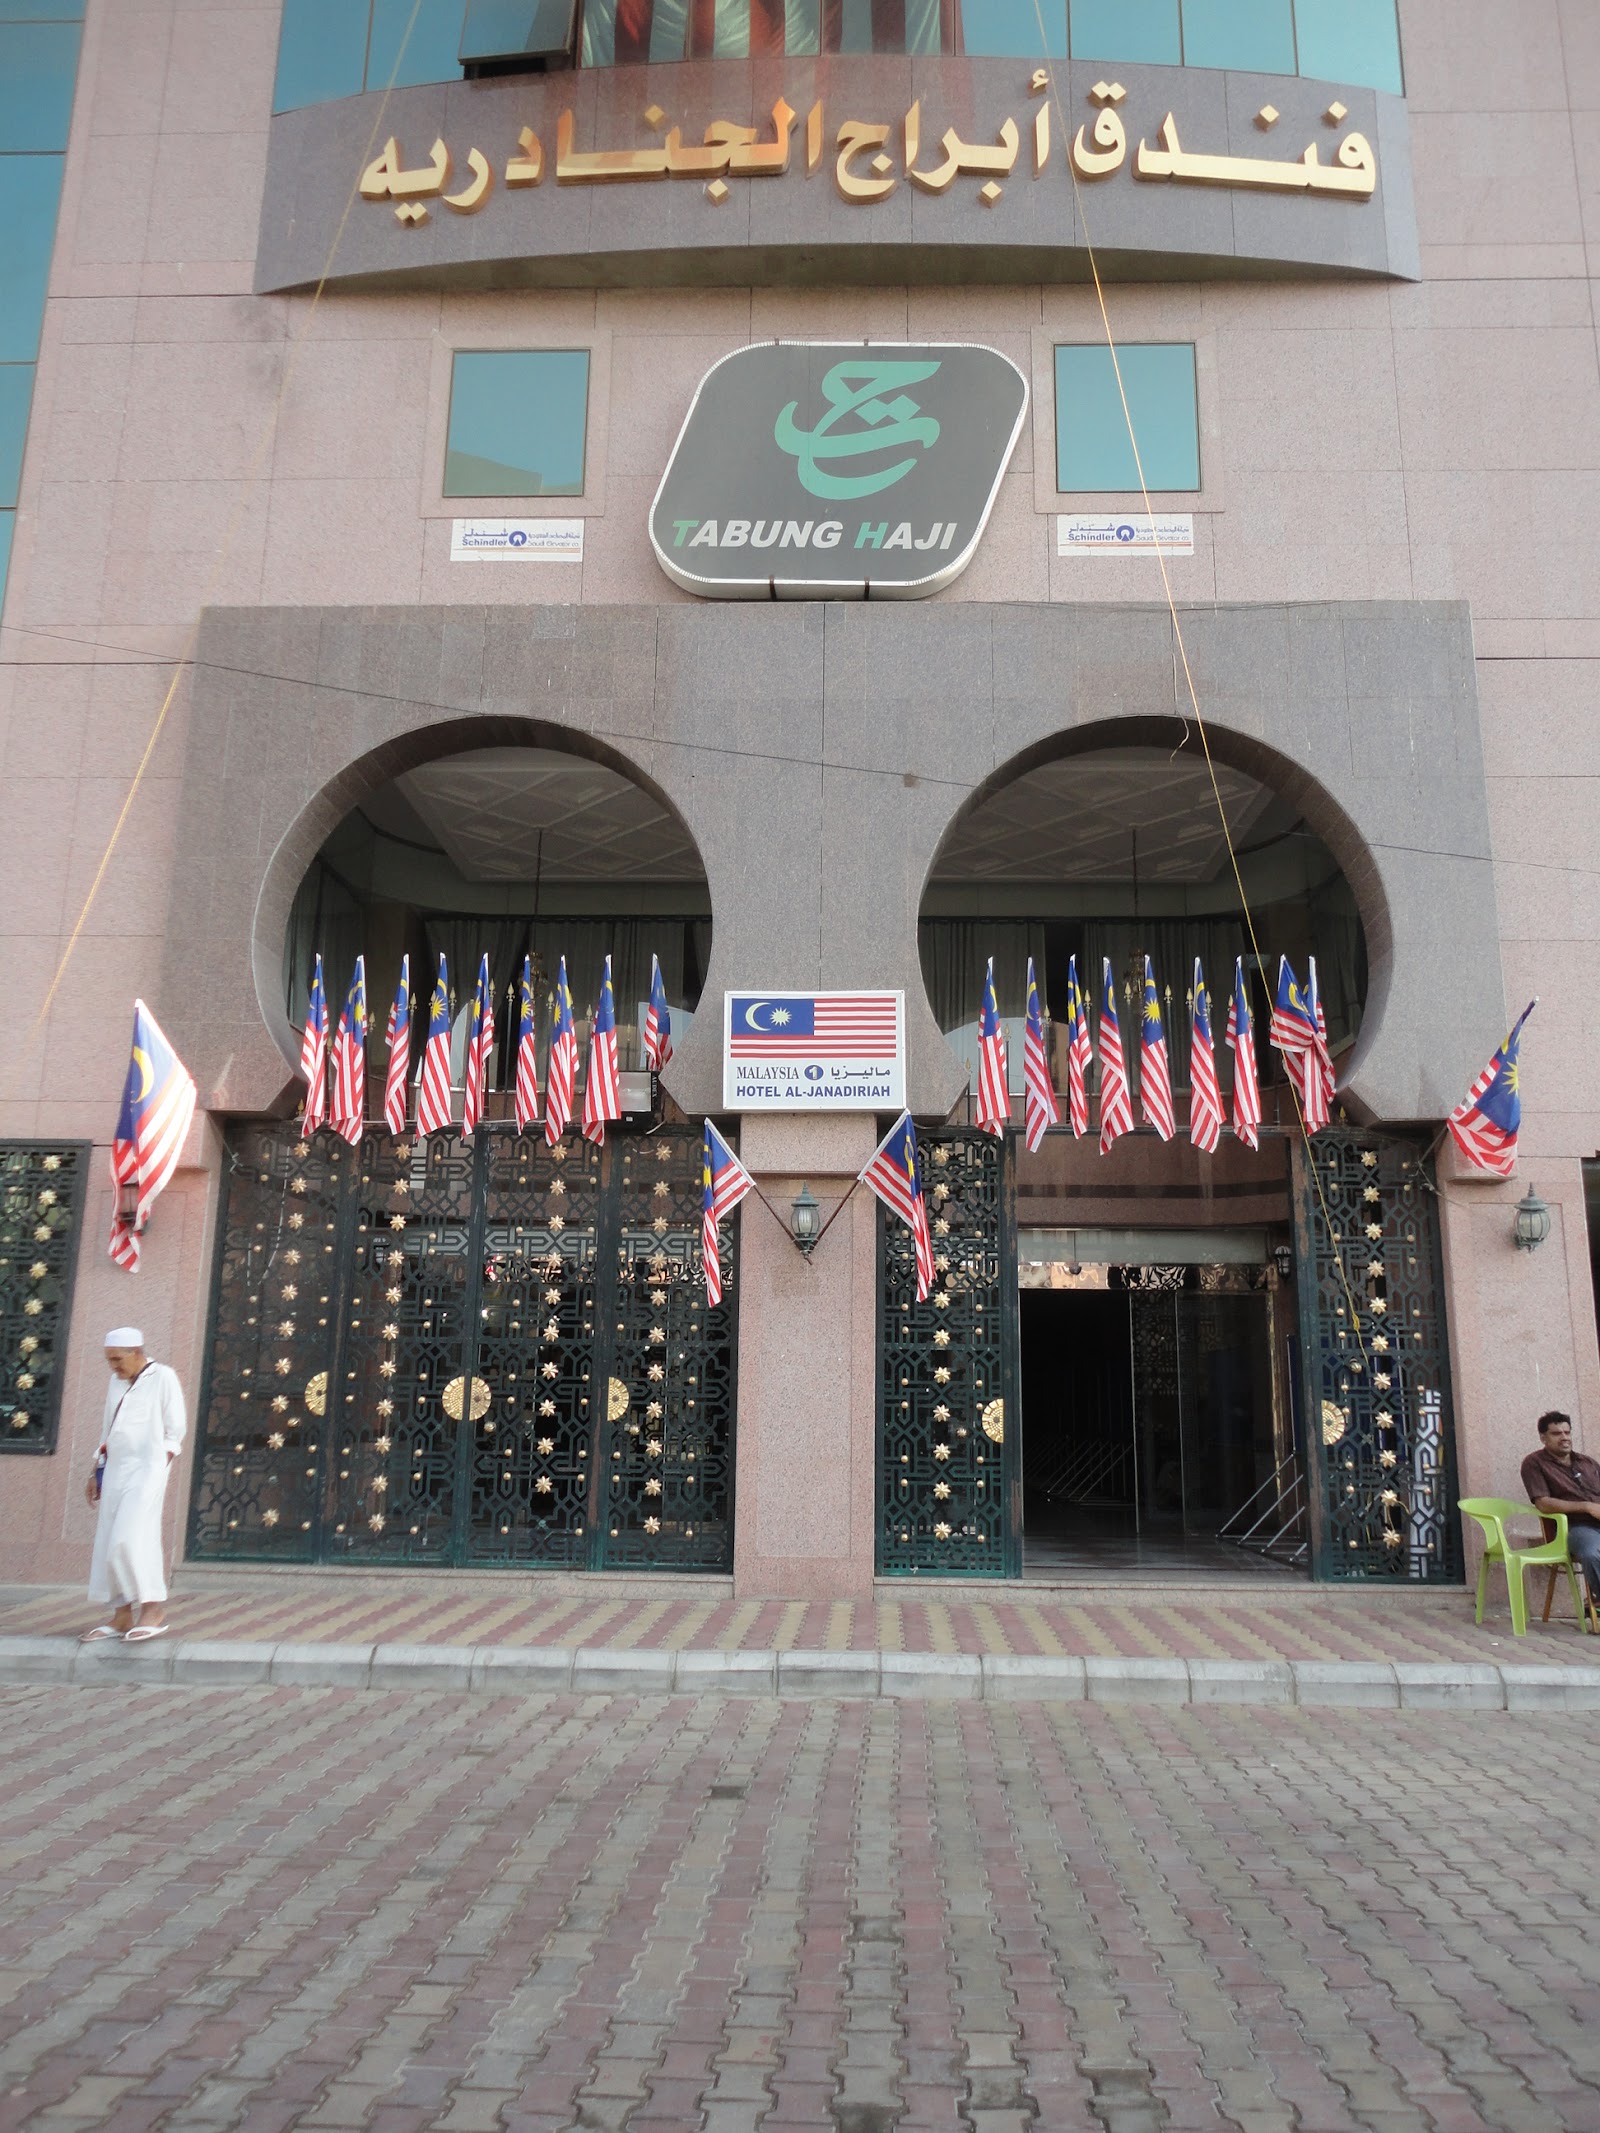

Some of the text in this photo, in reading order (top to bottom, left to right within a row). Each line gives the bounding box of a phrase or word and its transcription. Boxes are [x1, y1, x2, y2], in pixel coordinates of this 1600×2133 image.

[836, 68, 1050, 208] أبراج
[1072, 80, 1377, 202] فندق
[672, 519, 958, 550] TABUNG HAJI
[1068, 533, 1116, 541] Schindler
[462, 538, 508, 546] Schindler
[736, 1066, 818, 1080] MALAYSIA 1
[831, 1065, 891, 1080] ماليزيا
[736, 1085, 891, 1097] HOTEL AL-JANADIRIAH
